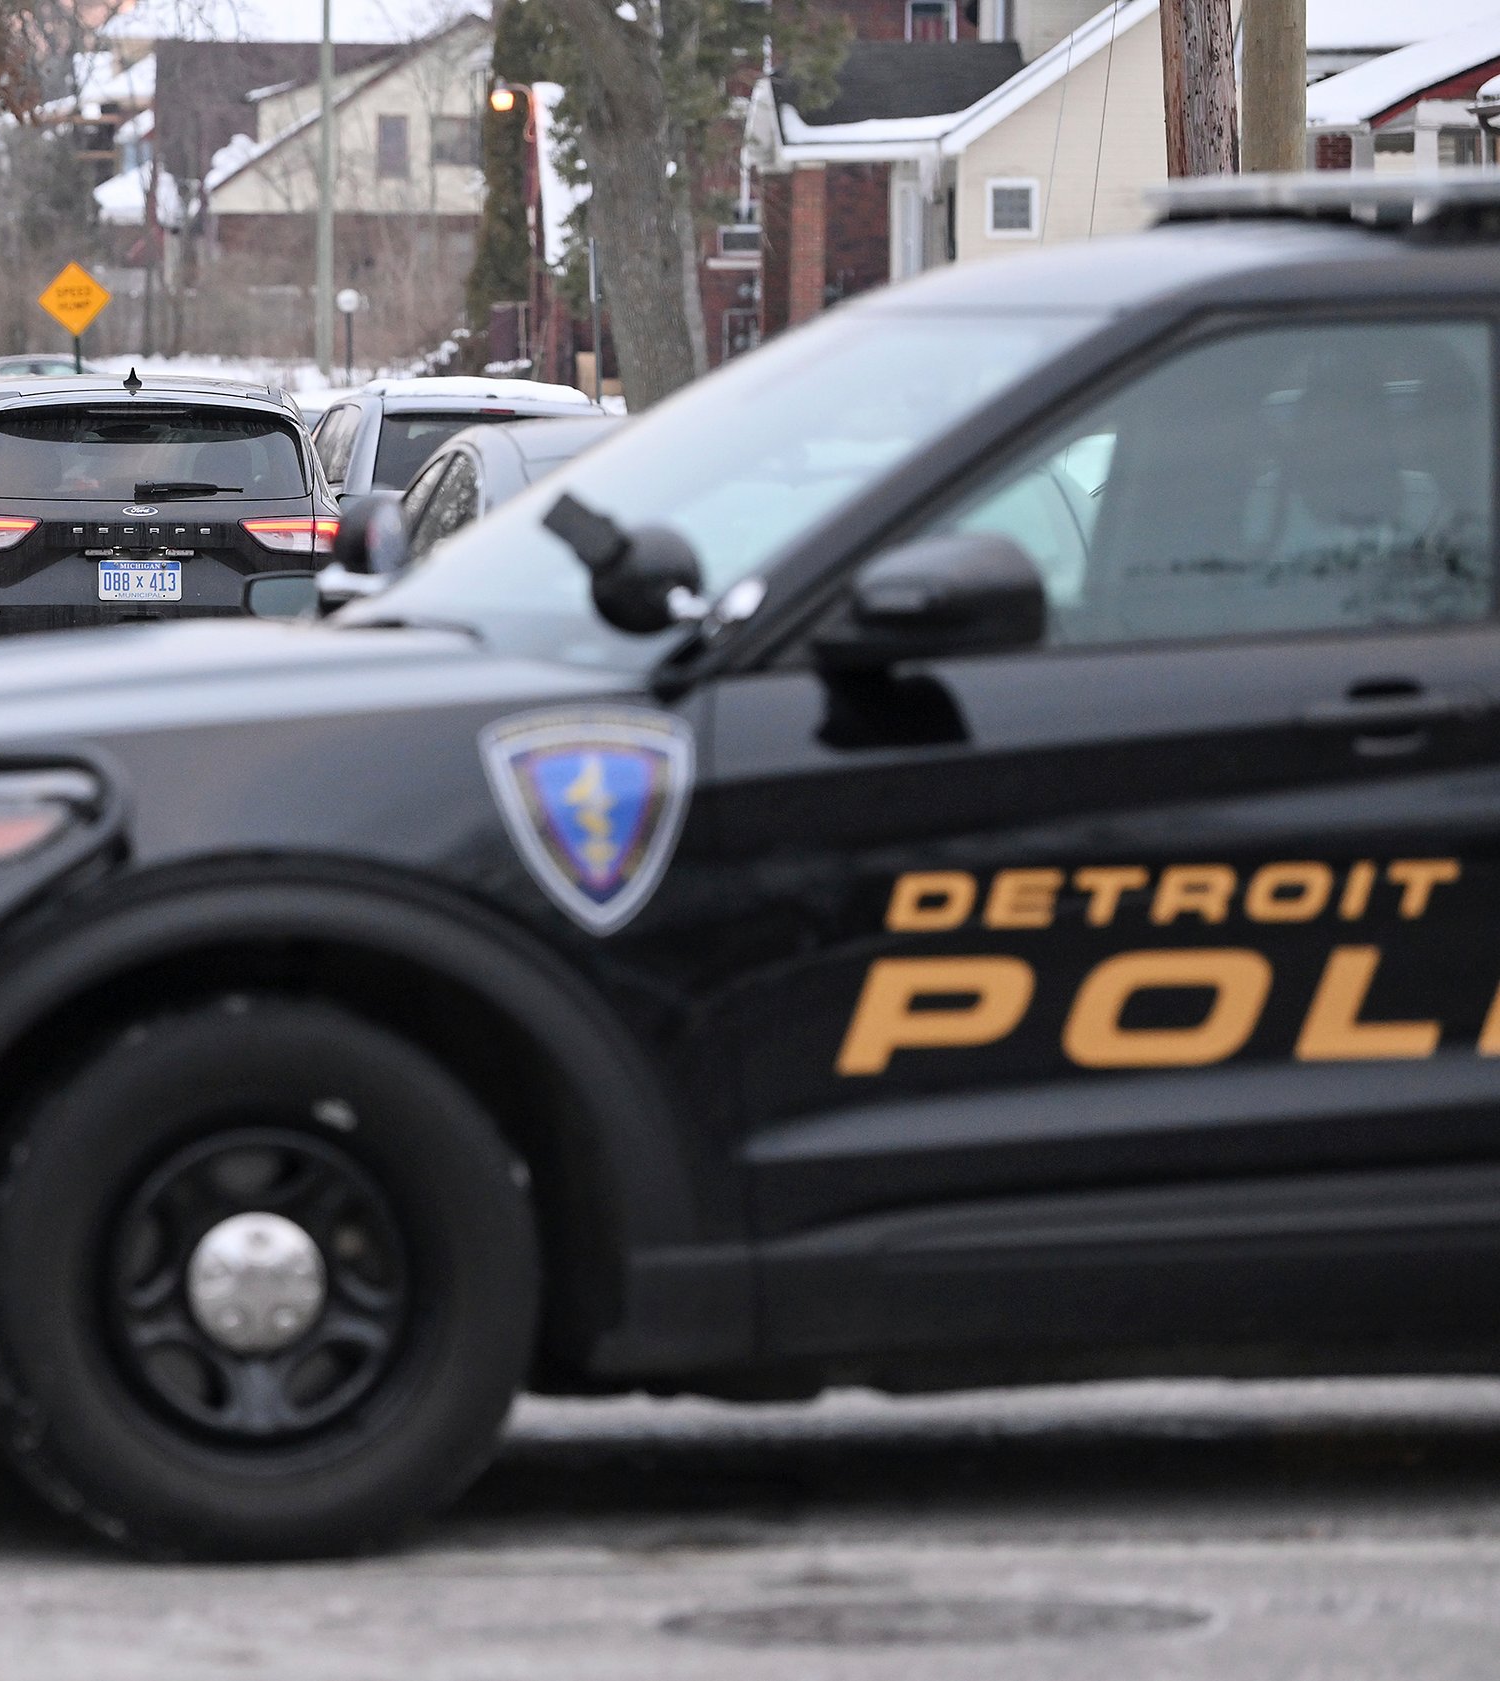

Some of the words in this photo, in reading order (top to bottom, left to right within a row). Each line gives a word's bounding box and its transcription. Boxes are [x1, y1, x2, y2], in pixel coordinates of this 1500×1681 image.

[56, 285, 92, 298] SPEED
[58, 299, 91, 311] HUMP
[72, 527, 211, 535] ESCAPE
[104, 572, 130, 591] 088
[149, 572, 176, 592] 413
[884, 858, 1461, 932] DETROIT
[835, 945, 1500, 1076] POL
